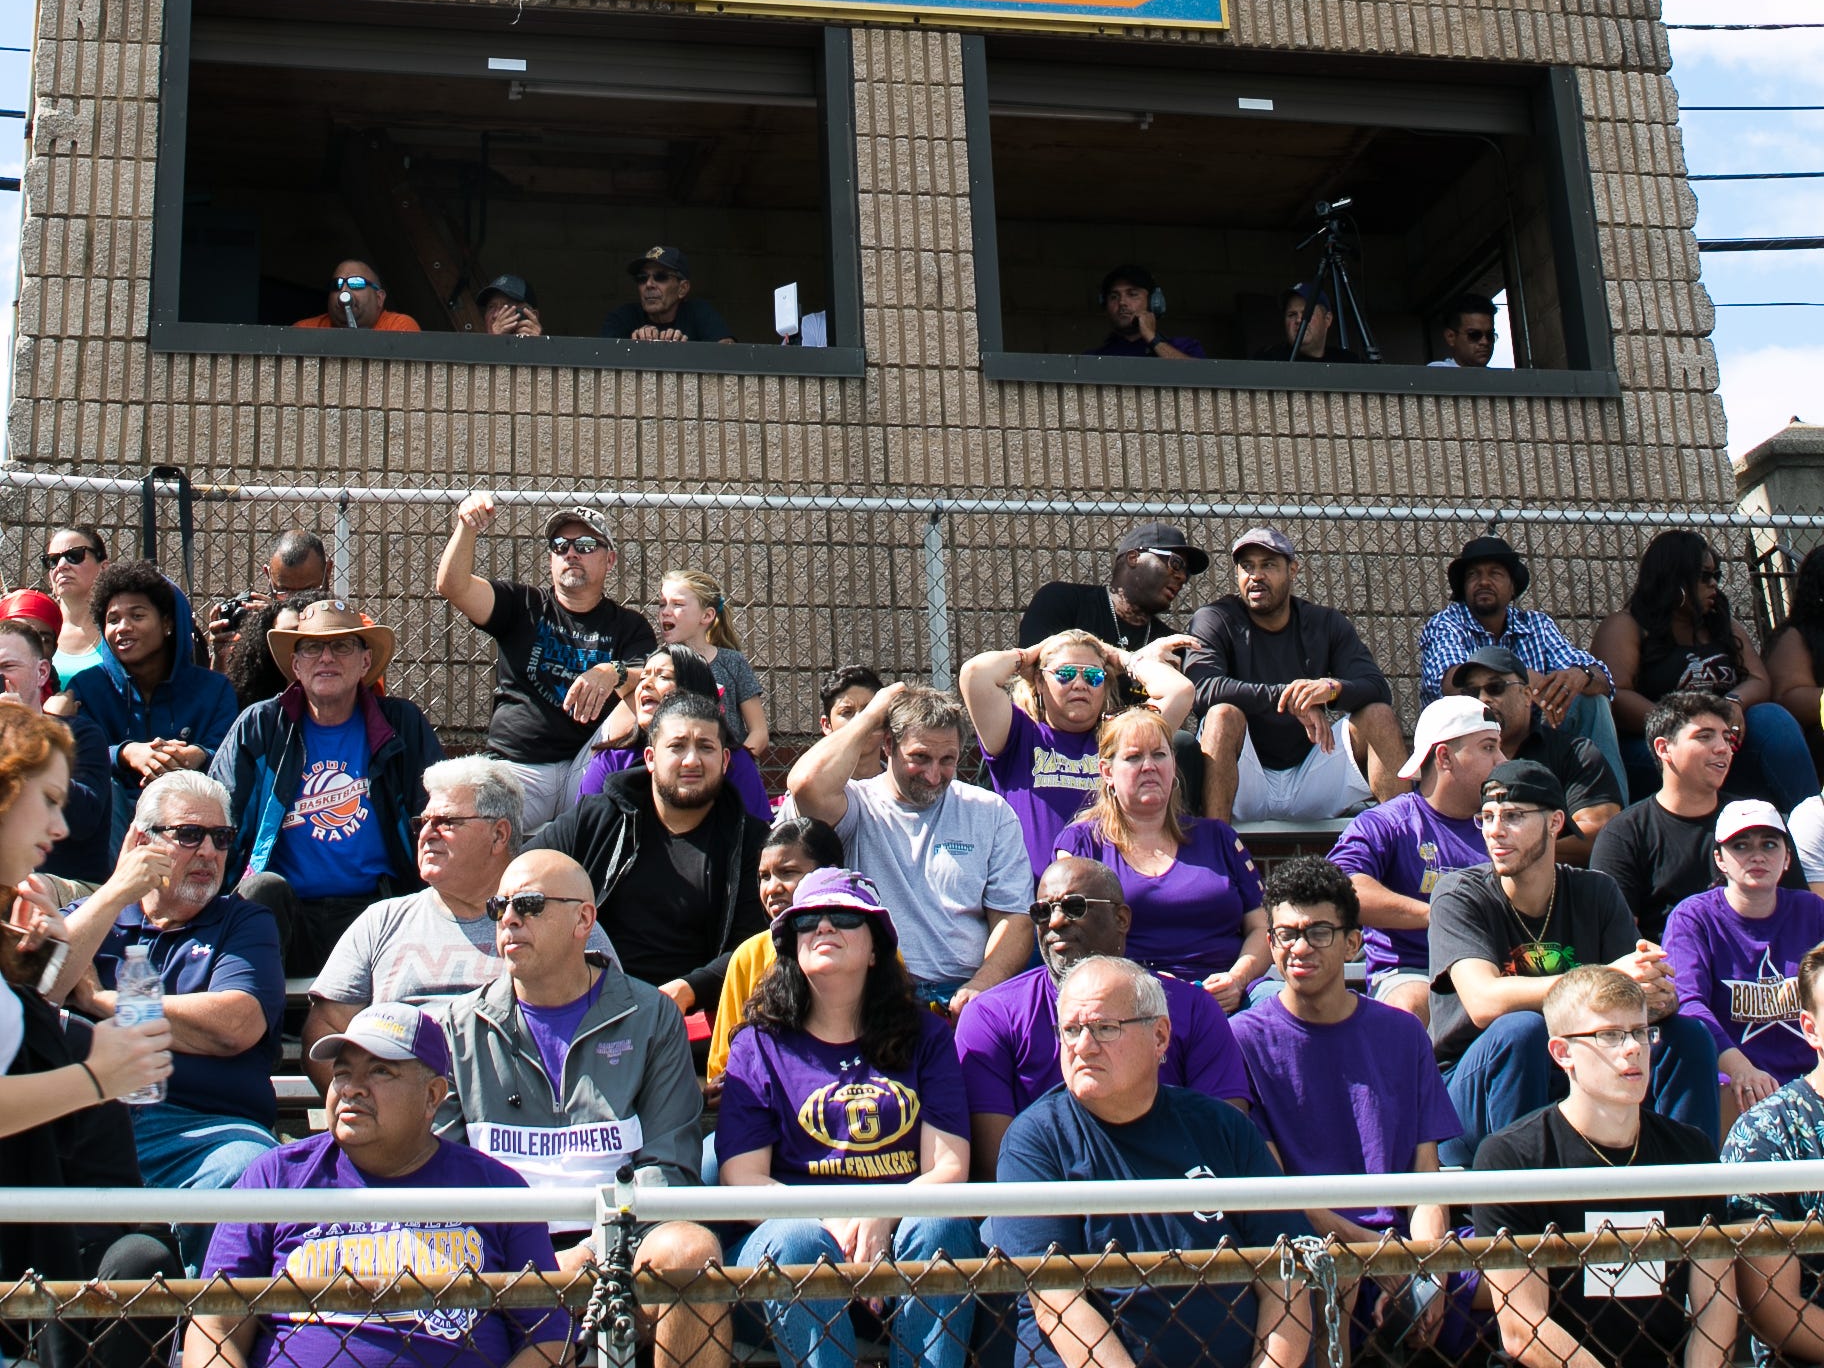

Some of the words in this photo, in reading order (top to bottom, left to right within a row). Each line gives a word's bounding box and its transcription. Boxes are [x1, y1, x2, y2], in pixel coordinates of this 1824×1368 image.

[302, 760, 347, 781] LODI
[300, 778, 368, 811] BASKETBALL
[311, 806, 369, 841] RAMS
[1732, 980, 1801, 1016] BOILERMA
[846, 1098, 880, 1142] G
[490, 1125, 623, 1156] BOILERMAKERS
[808, 1150, 918, 1178] BOILERMAKERS
